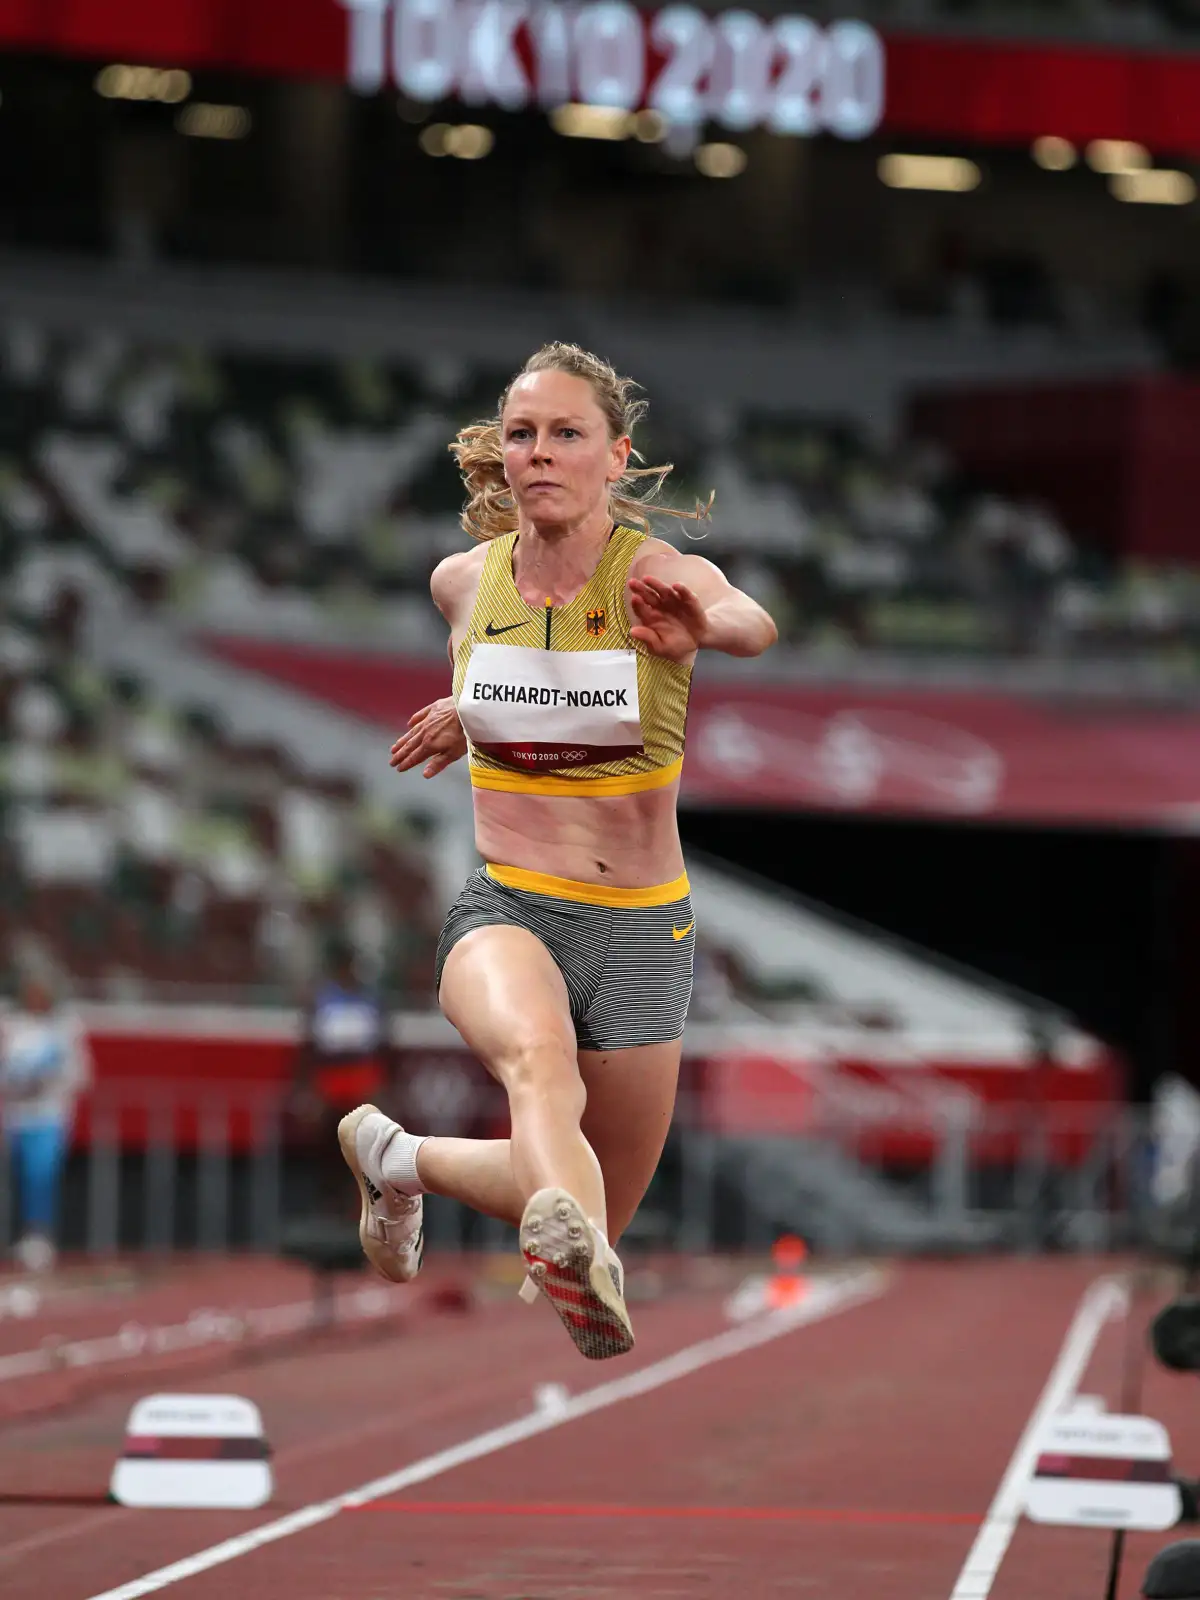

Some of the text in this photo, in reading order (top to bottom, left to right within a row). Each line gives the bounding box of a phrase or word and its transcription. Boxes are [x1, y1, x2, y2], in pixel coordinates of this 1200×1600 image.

[340, 0, 885, 140] TOKYO 2020
[473, 682, 628, 707] ECKHARDT-NOACK
[511, 750, 559, 761] TOKYO 2020
